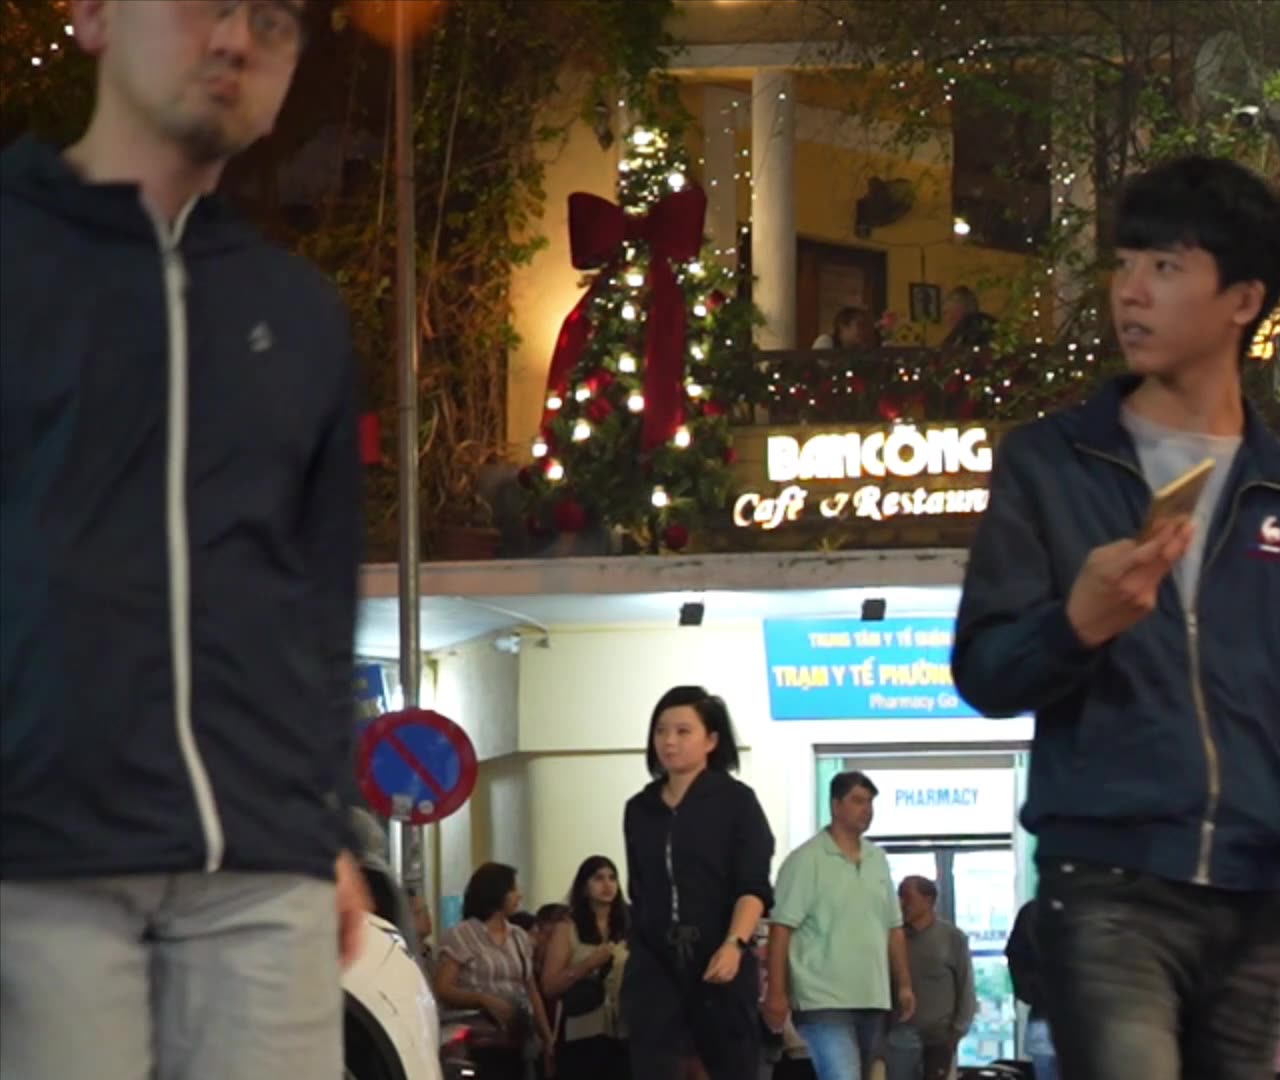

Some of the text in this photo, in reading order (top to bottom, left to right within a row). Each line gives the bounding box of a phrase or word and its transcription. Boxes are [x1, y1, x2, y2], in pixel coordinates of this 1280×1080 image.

[772, 665, 829, 690] TRẠM
[831, 665, 847, 686] Y
[850, 656, 875, 686] TẾ
[895, 787, 978, 806] PHARMACY
